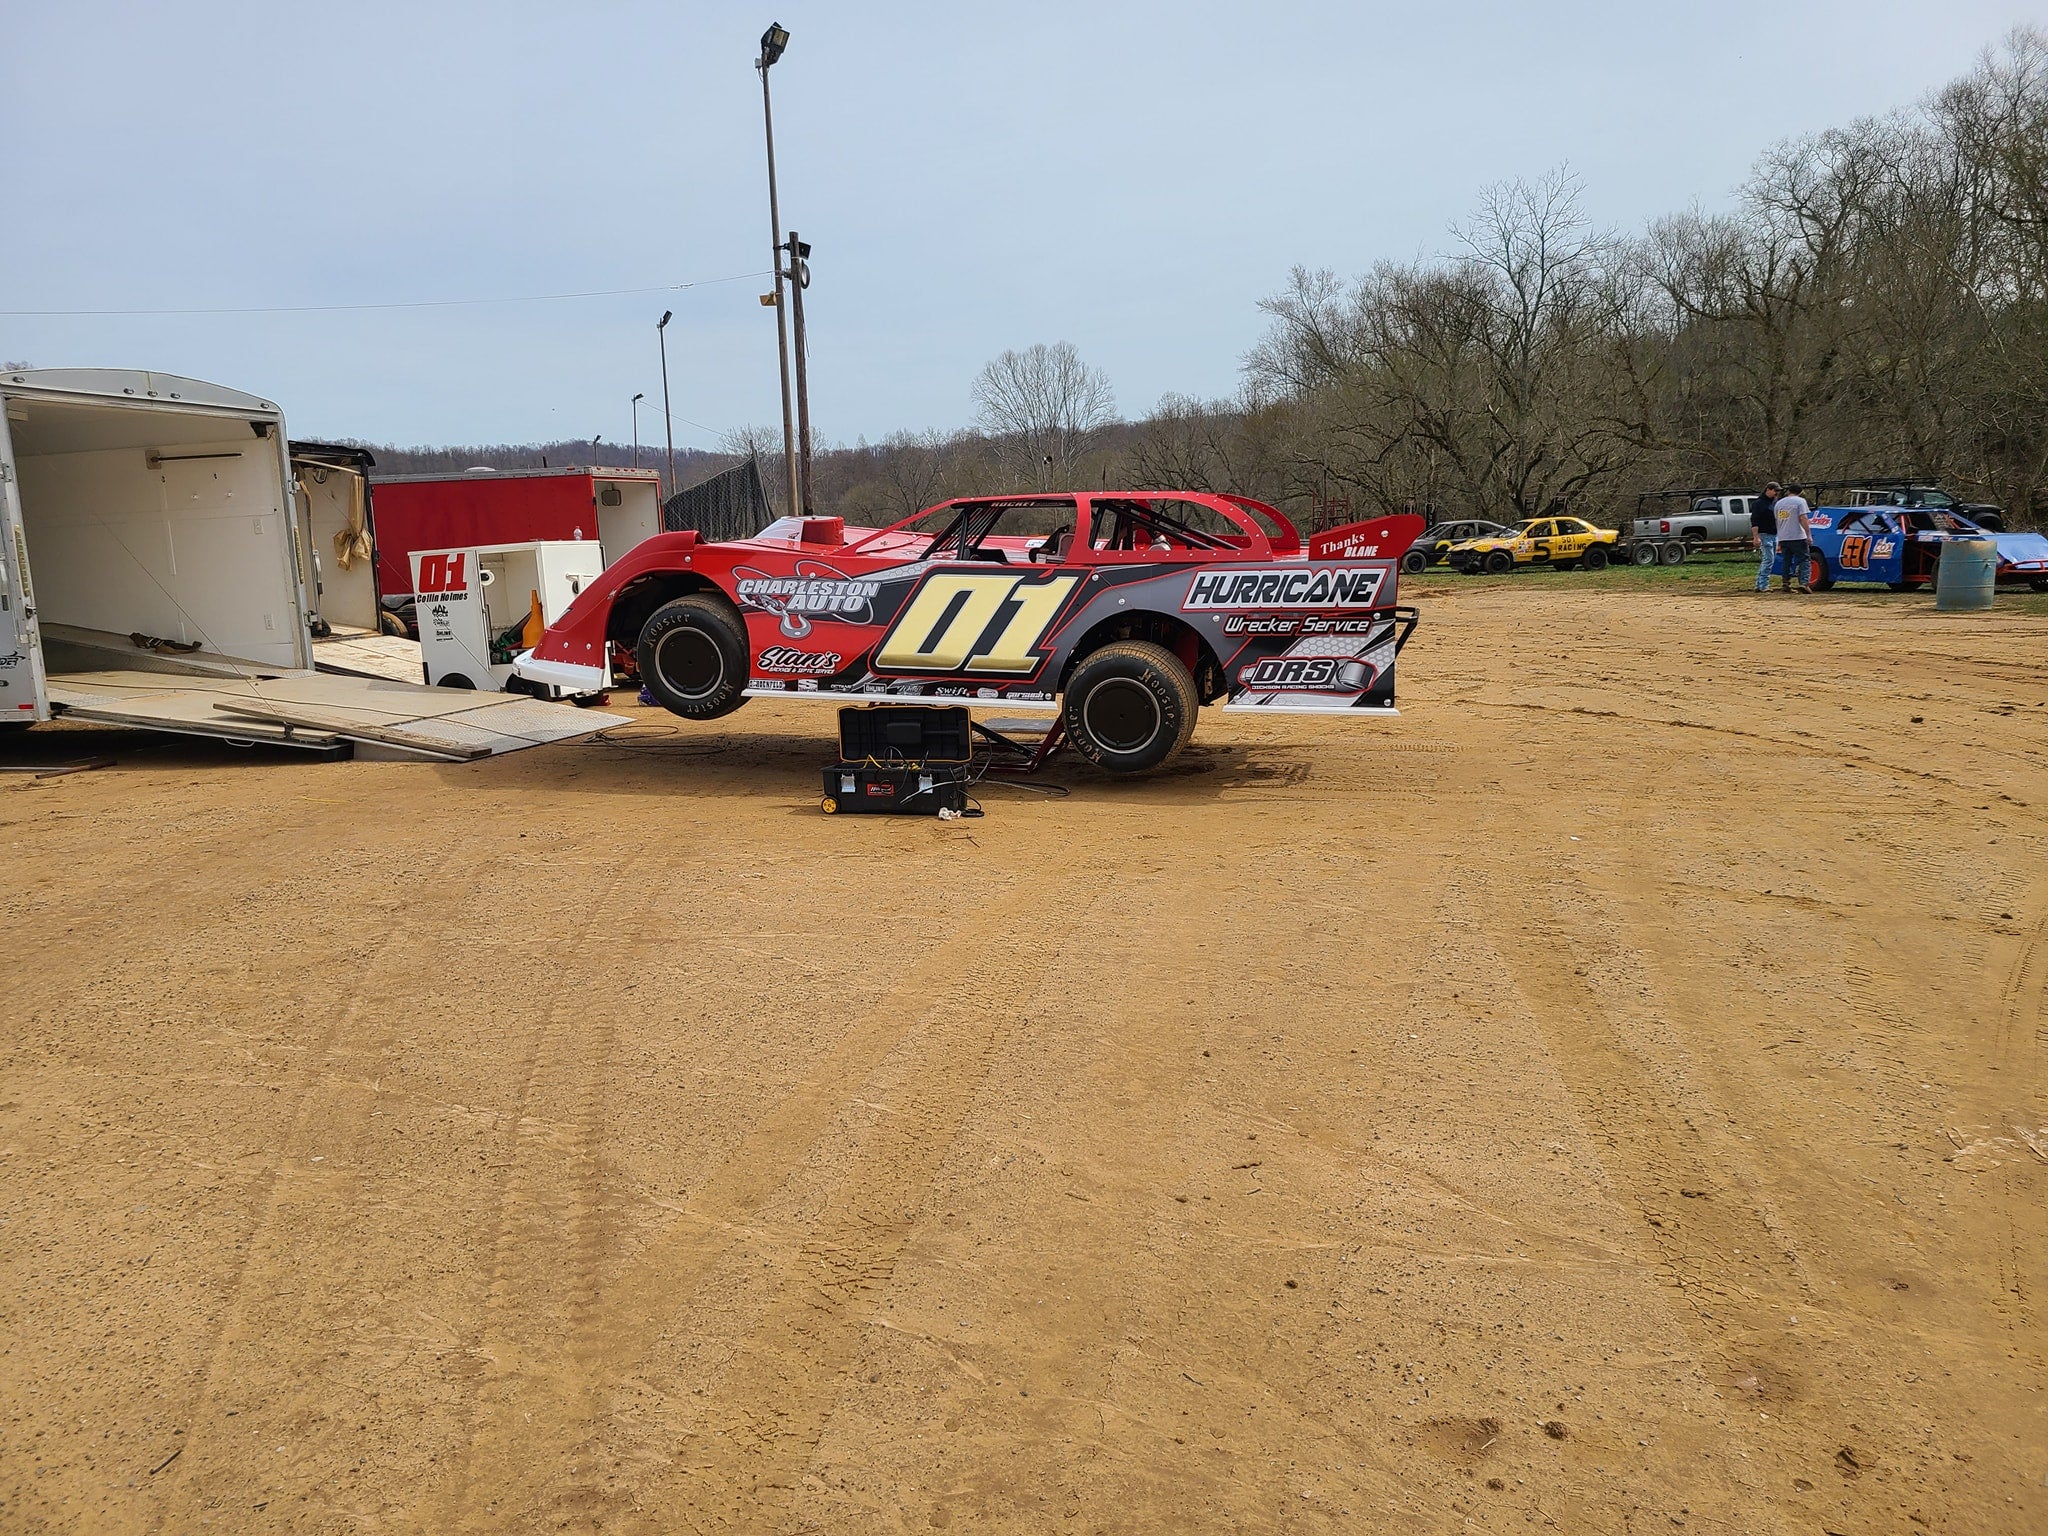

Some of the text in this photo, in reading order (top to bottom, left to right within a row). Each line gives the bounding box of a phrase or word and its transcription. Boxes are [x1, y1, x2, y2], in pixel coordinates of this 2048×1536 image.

[1320, 533, 1365, 555] Thanks
[1343, 545, 1379, 558] BLANE
[1532, 538, 1551, 563] 5
[1558, 543, 1587, 551] RACING
[419, 553, 468, 593] 01
[416, 592, 469, 603] Collin Holmes
[738, 579, 881, 597] CHARLESTON
[1187, 572, 1383, 606] HURRICANE
[785, 594, 867, 613] AUTO
[875, 574, 1079, 674] 01
[1225, 616, 1370, 632] Wrecker Service
[757, 645, 842, 670] Stan's
[1250, 659, 1335, 684] DRS
